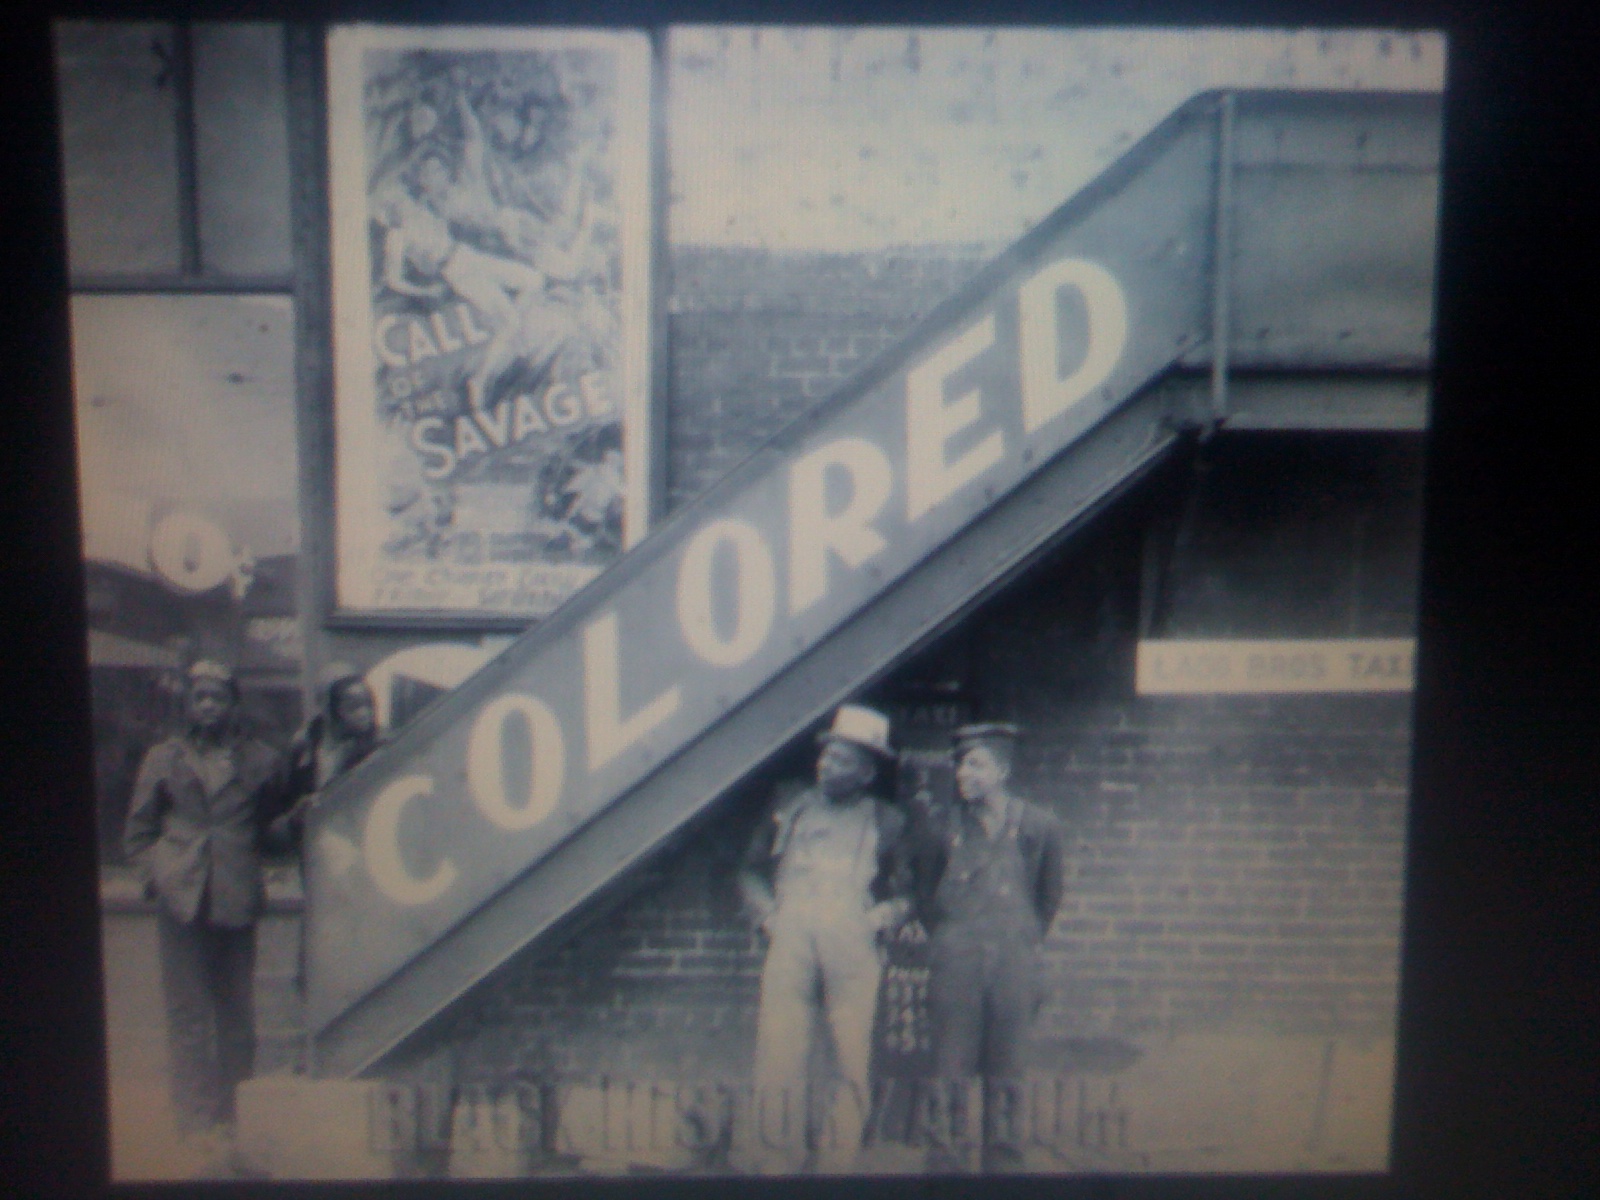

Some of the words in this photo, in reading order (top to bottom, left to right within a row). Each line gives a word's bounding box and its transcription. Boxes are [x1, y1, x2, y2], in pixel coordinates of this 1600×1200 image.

[377, 306, 489, 367] CALL
[411, 372, 614, 480] SAVAGE
[364, 257, 1129, 907] COLORED
